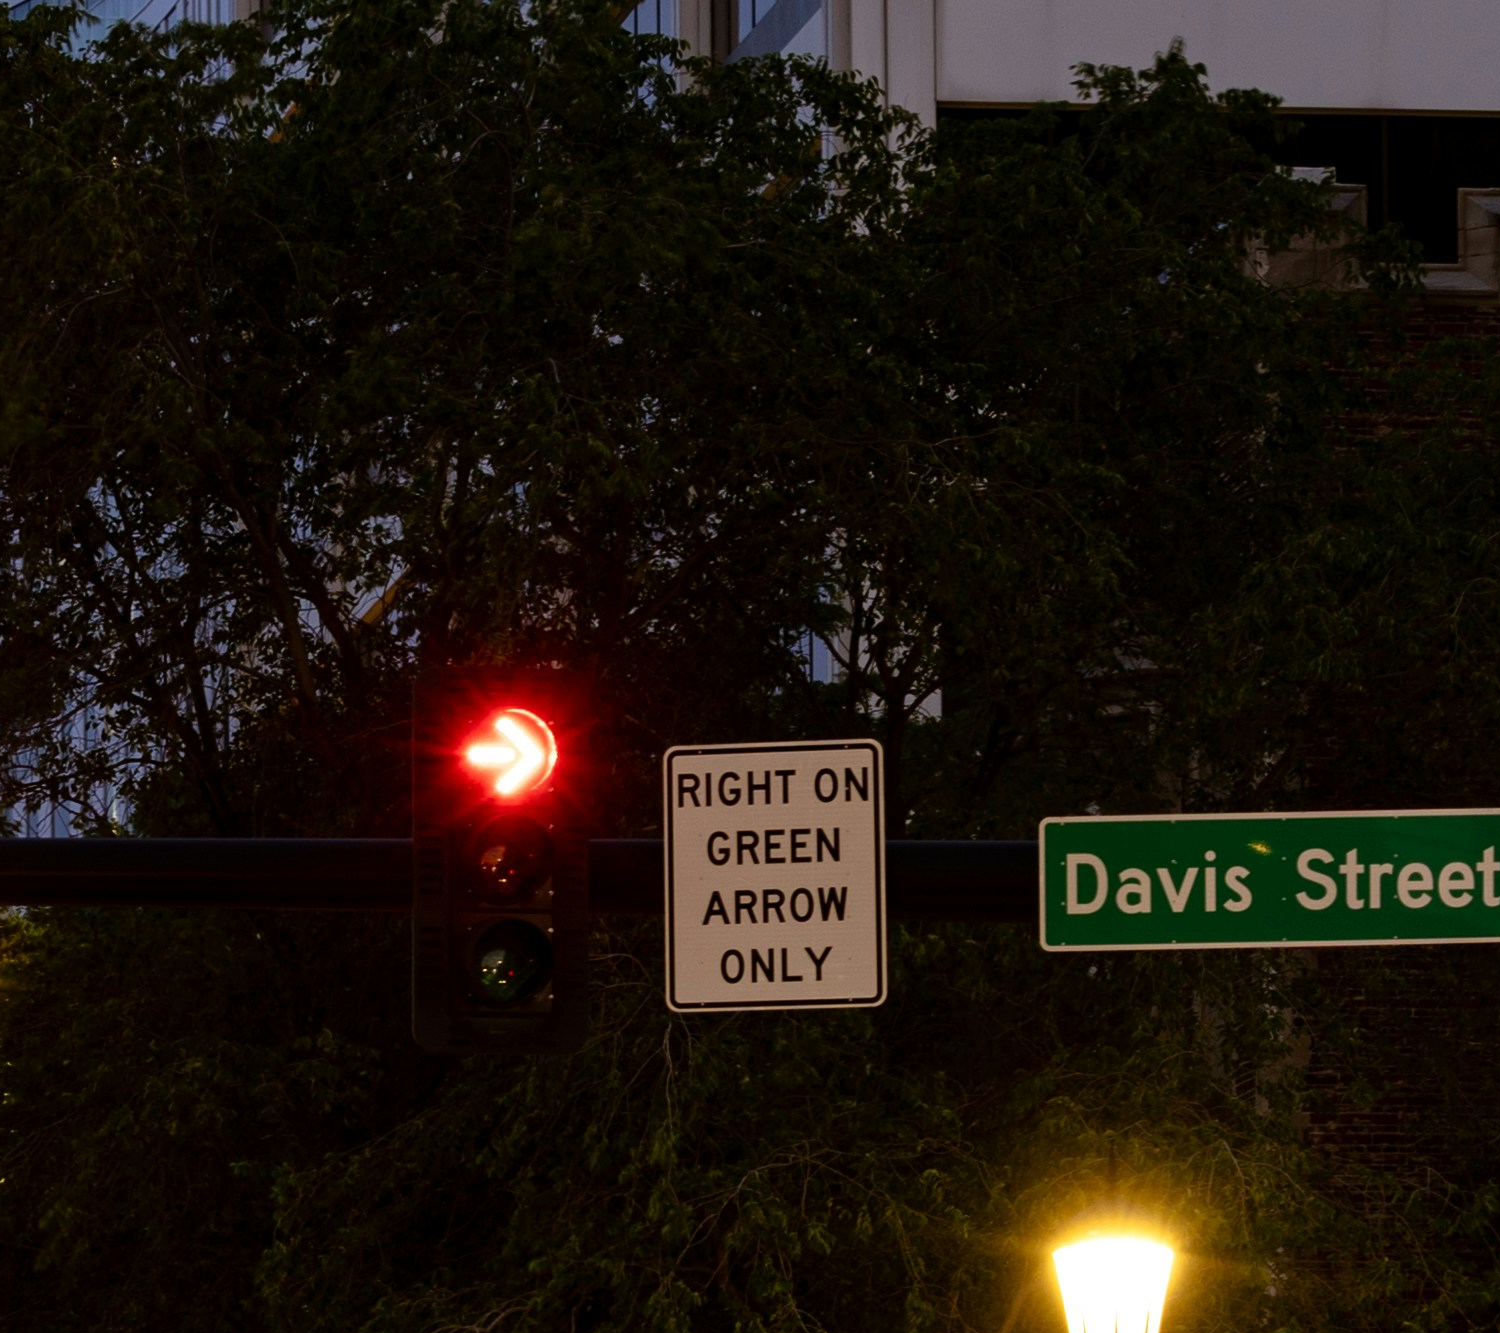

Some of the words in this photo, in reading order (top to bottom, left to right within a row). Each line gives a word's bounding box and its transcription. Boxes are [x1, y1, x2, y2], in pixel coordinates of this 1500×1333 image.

[676, 768, 796, 809] RIGHT
[813, 765, 871, 805] ON
[706, 827, 842, 867] GREEN
[1064, 850, 1252, 916] Davis
[701, 885, 849, 926] ARROW
[720, 945, 833, 985] ONLY
